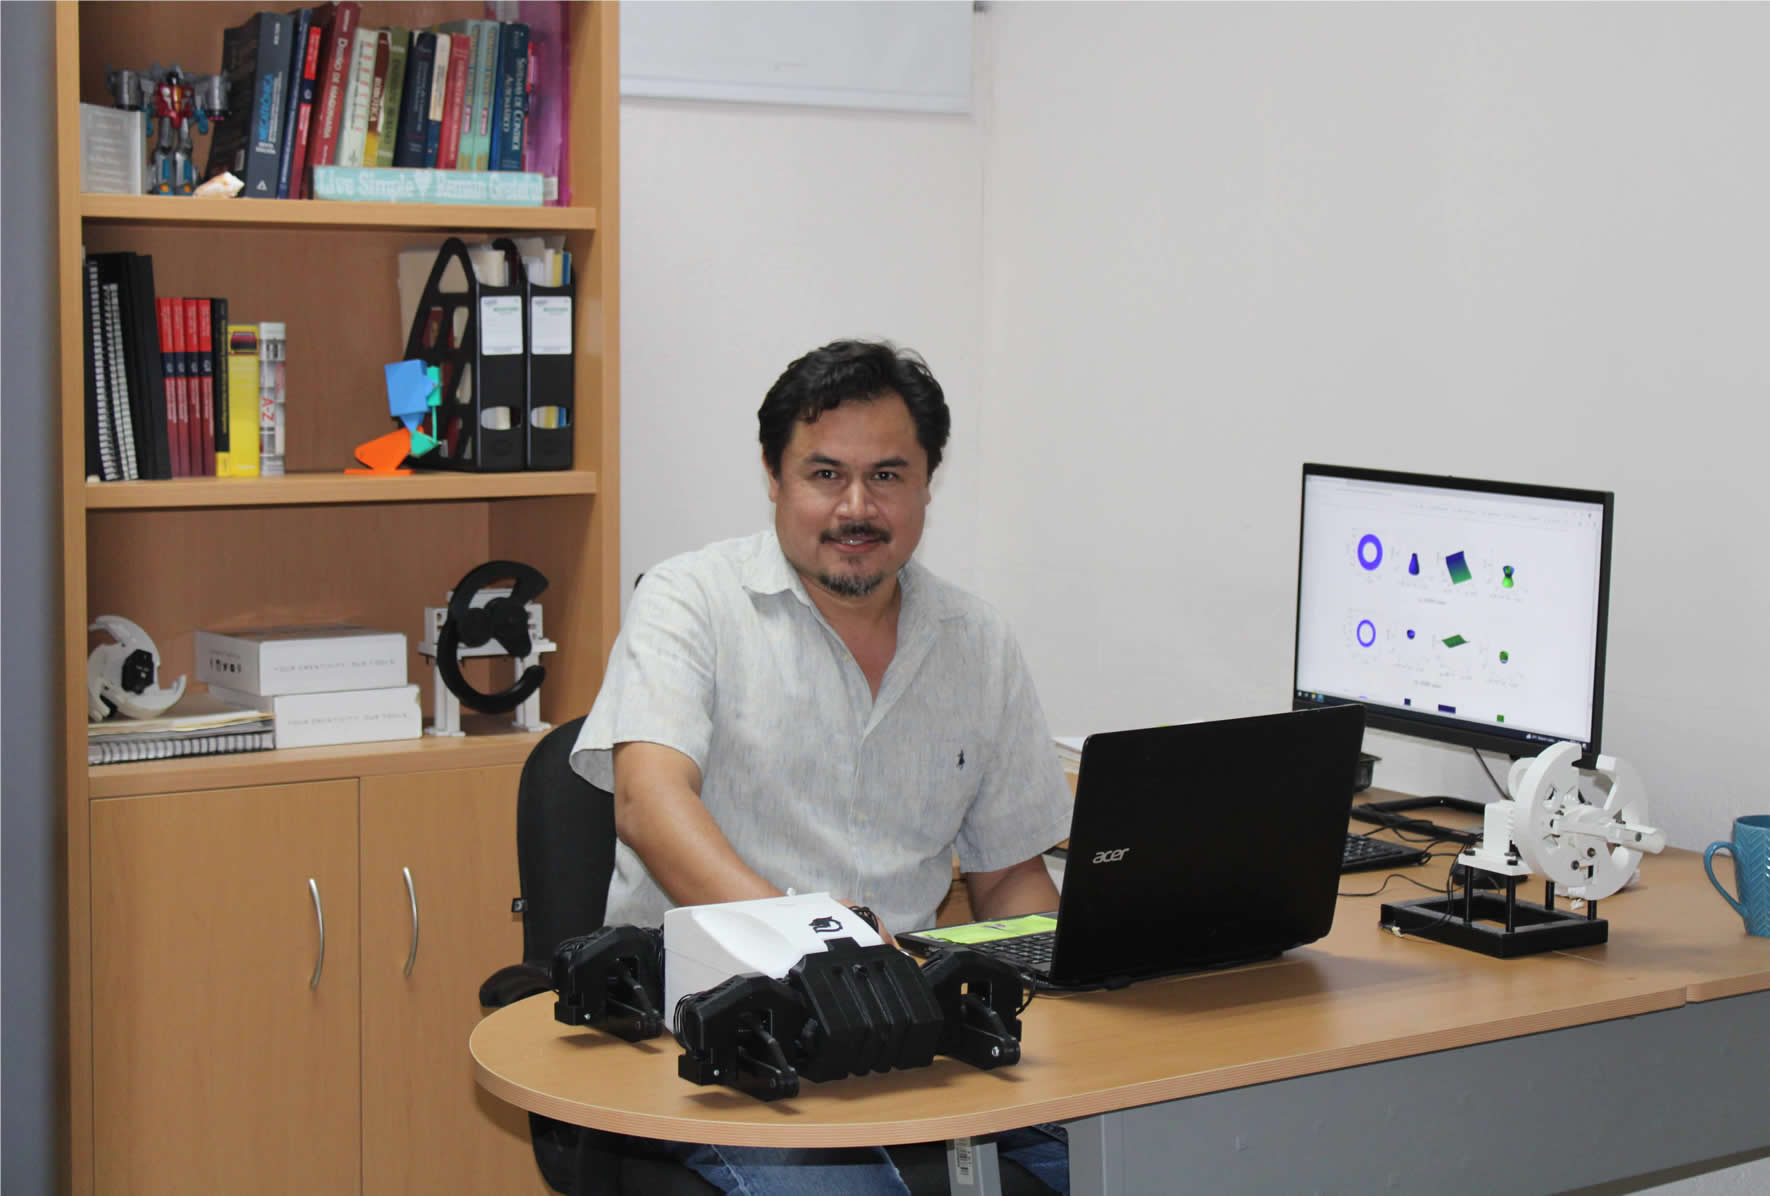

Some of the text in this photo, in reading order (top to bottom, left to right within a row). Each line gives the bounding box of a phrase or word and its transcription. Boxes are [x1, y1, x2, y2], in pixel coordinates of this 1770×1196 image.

[317, 169, 355, 195] Live
[358, 170, 416, 203] Simple
[262, 396, 277, 423] A-Z
[1092, 847, 1131, 864] acer
